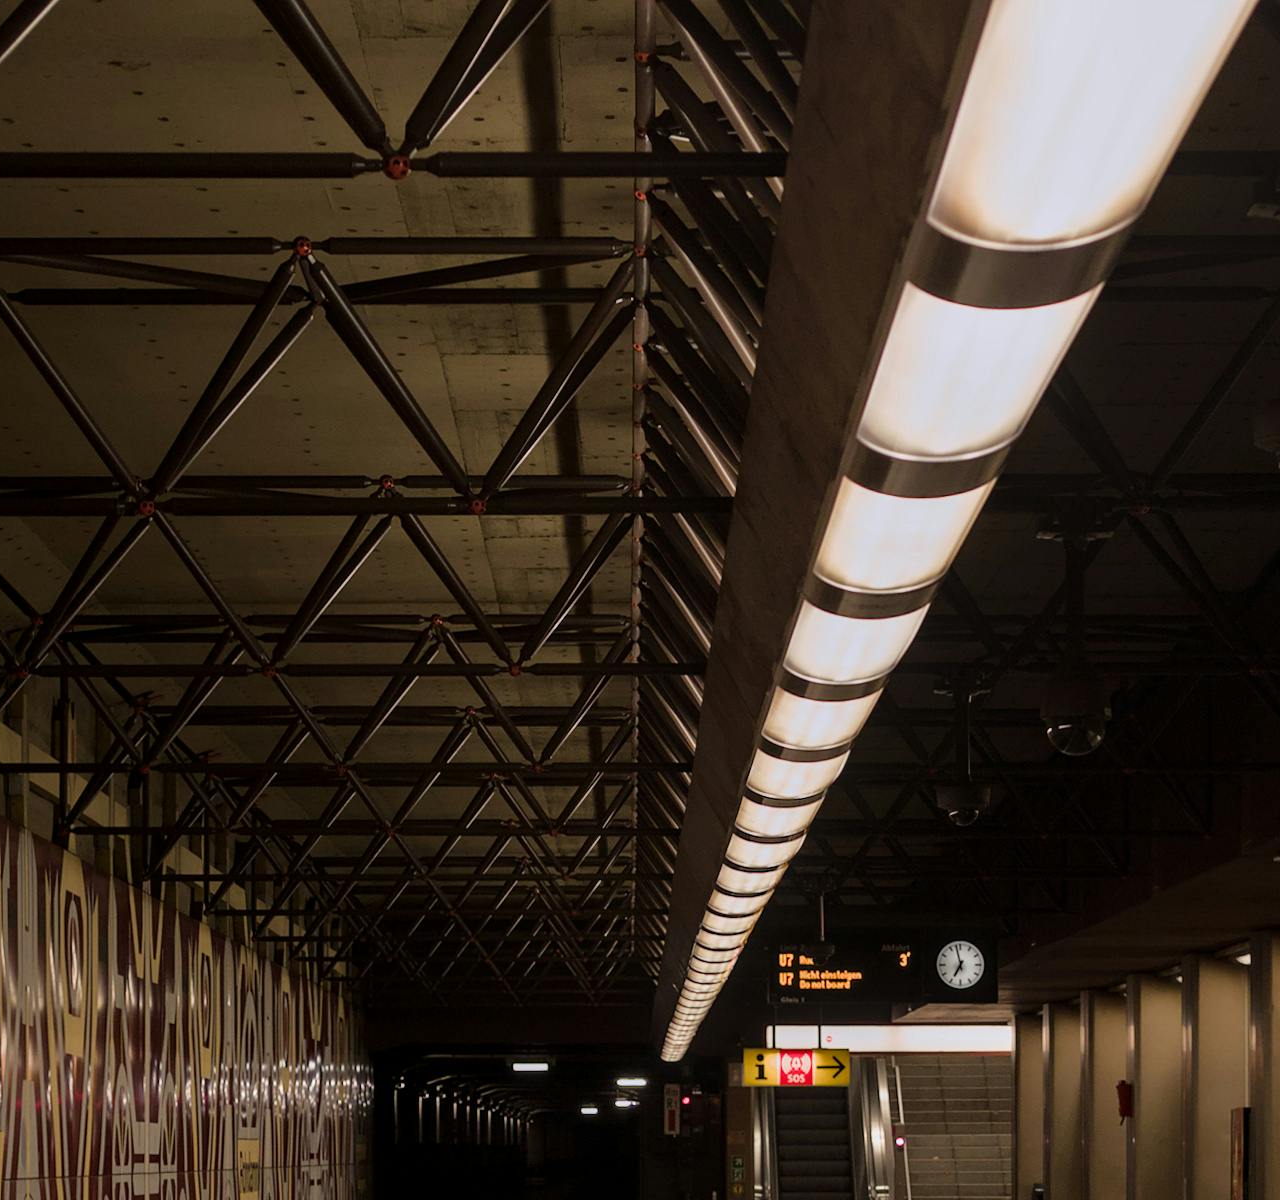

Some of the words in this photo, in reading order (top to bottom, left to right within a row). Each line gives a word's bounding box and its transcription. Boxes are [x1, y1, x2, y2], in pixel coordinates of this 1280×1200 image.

[779, 953, 794, 967] U7
[779, 972, 794, 986] U7
[799, 970, 820, 980] Nicht
[821, 970, 862, 981] einsteigen
[799, 980, 810, 989] Do
[811, 980, 825, 989] not
[826, 980, 851, 989] board
[787, 1074, 806, 1083] SOS
